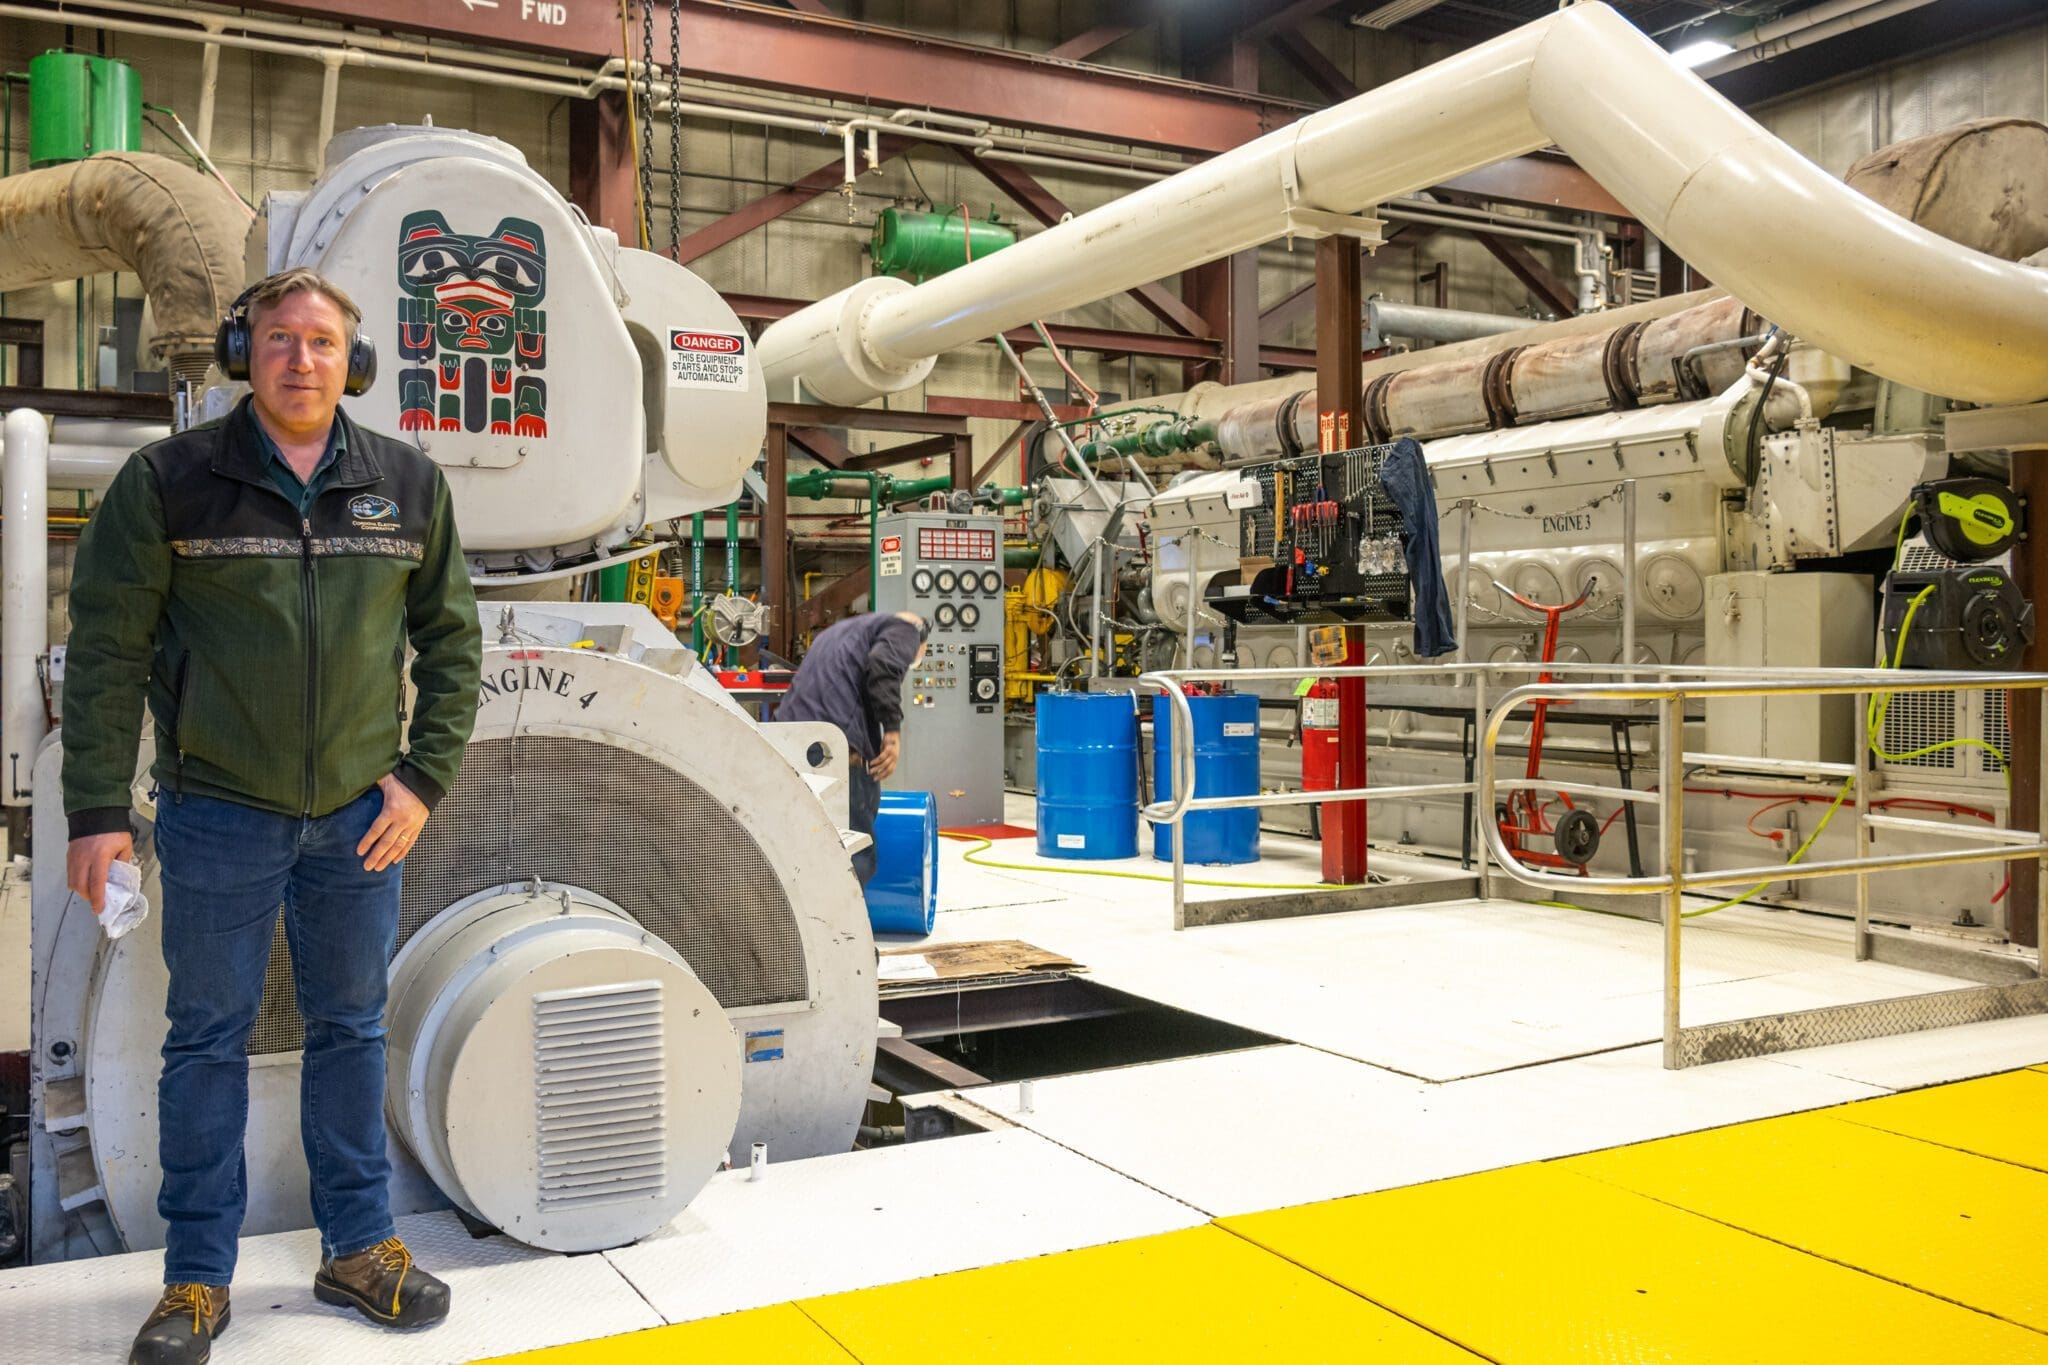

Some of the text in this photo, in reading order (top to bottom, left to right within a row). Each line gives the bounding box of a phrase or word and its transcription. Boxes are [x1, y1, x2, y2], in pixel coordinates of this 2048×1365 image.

[522, 0, 567, 26] FWD
[681, 336, 734, 350] DANGER
[678, 353, 737, 366] THIS EQUIPMENT
[672, 361, 743, 375] STARTS AND STOPS
[678, 371, 738, 384] AUTOMATICALLY
[1321, 417, 1335, 432] FIRE
[1542, 513, 1591, 533] ENGINE 3
[477, 665, 598, 710] NGINE 4
